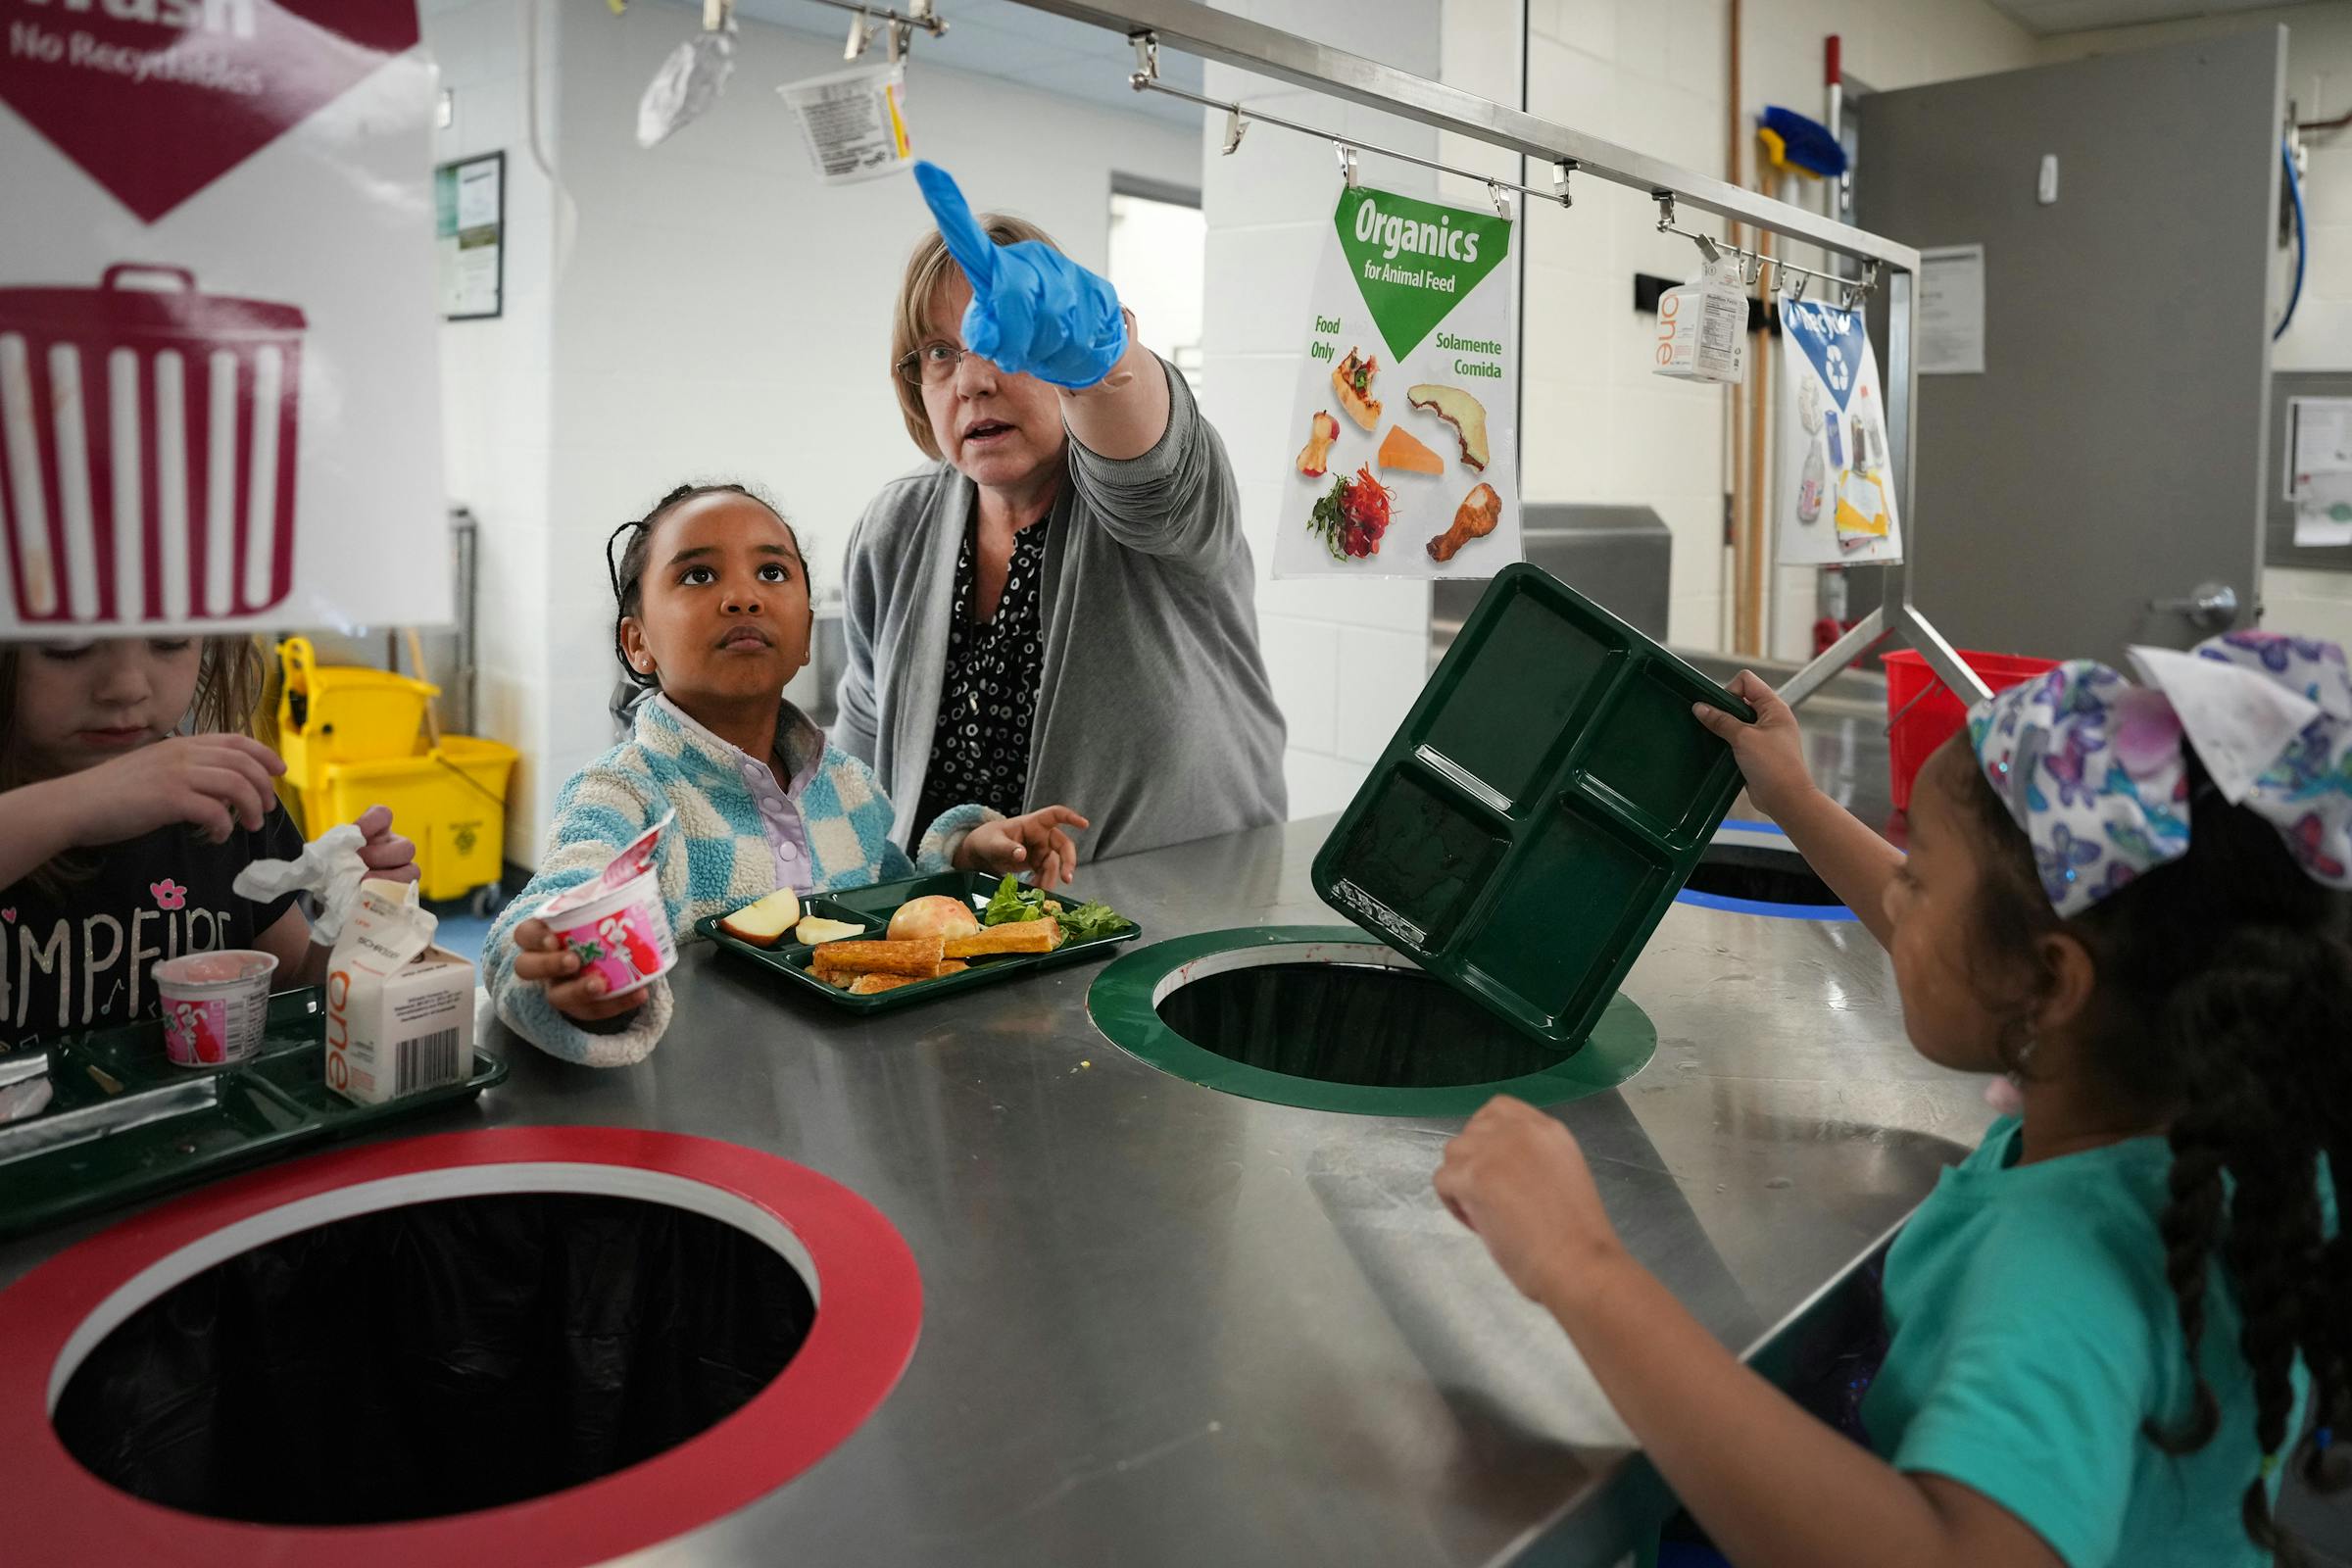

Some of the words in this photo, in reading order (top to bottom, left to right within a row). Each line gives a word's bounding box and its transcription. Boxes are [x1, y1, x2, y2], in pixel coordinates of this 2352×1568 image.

[10, 21, 64, 61] No
[1355, 198, 1480, 263] Organics
[1364, 259, 1382, 280] for
[1382, 263, 1424, 288] Animal
[1425, 270, 1455, 293] Feed
[1315, 315, 1341, 334] Food
[1311, 340, 1335, 364] Only
[1436, 332, 1502, 355] Solamente
[1454, 359, 1502, 378] Comida
